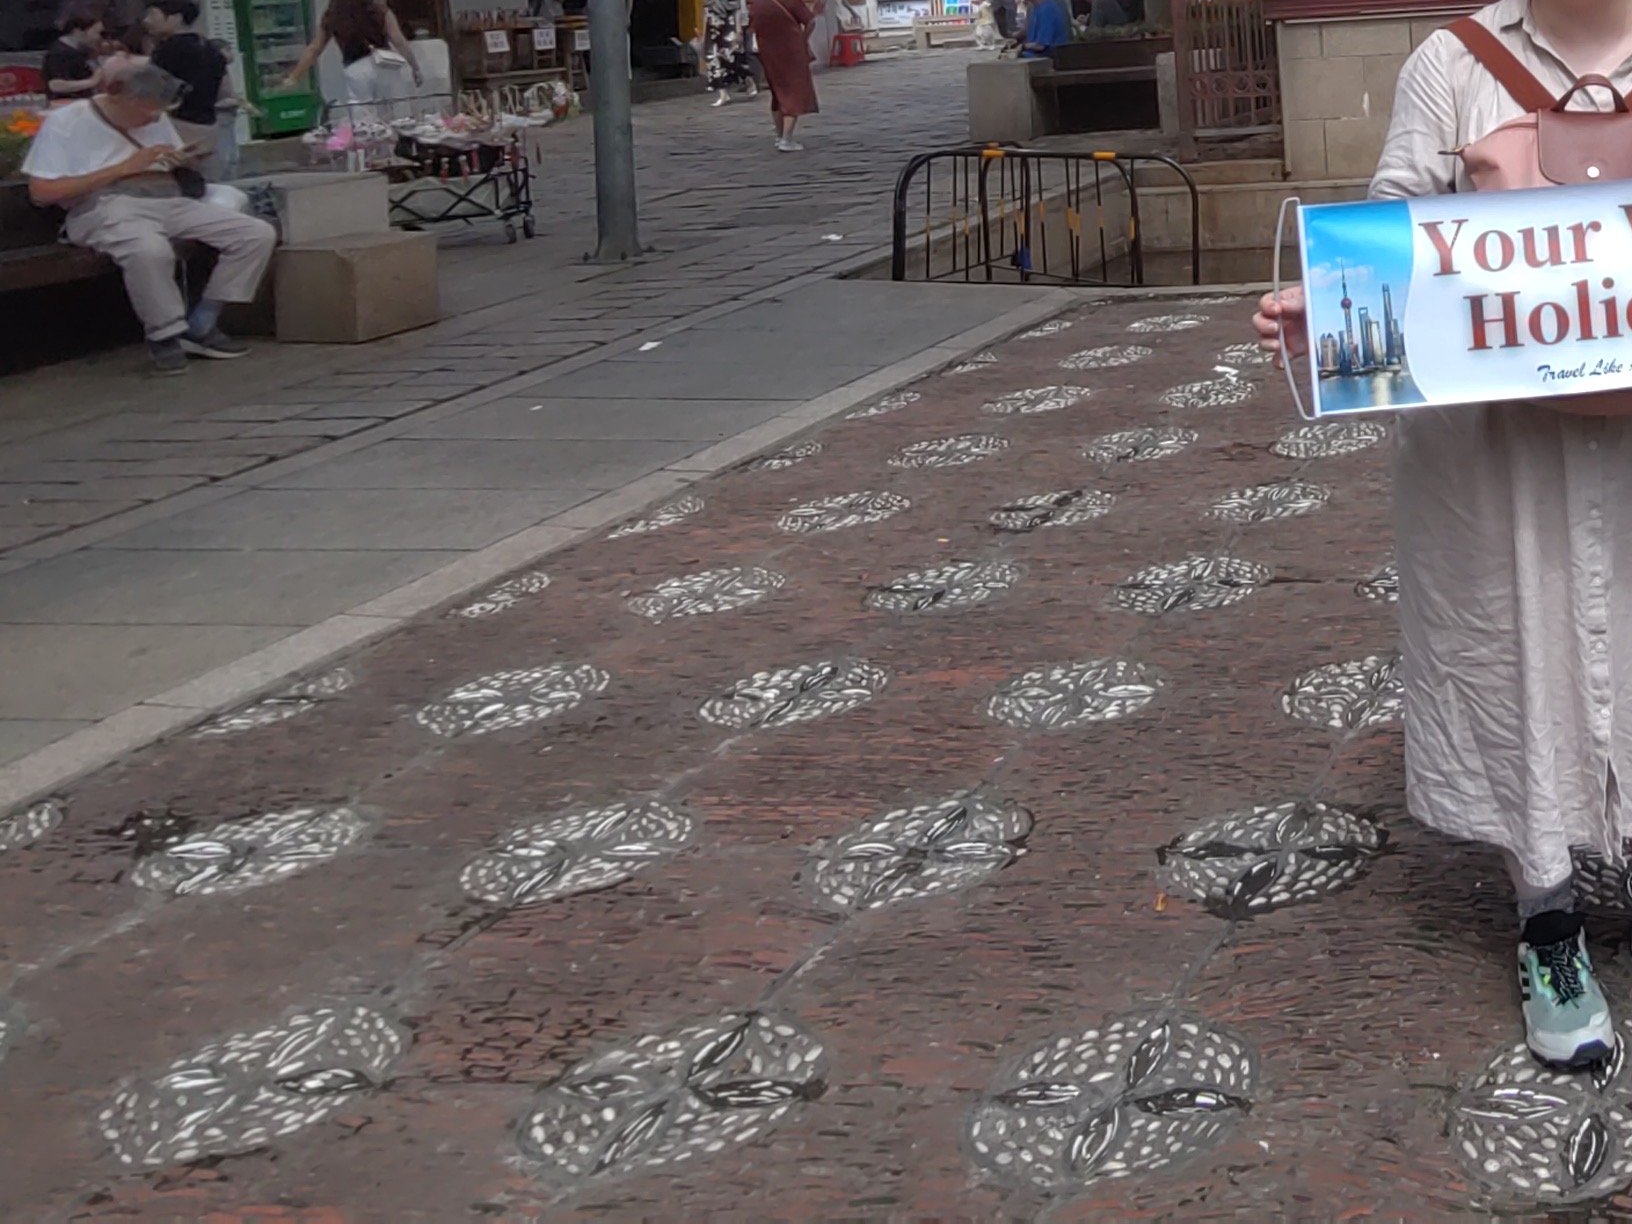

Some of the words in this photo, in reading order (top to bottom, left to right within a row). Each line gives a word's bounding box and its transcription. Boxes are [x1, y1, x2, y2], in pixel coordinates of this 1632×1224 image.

[1418, 217, 1603, 277] Your
[1537, 361, 1586, 383] Travel
[1588, 358, 1624, 376] Like
